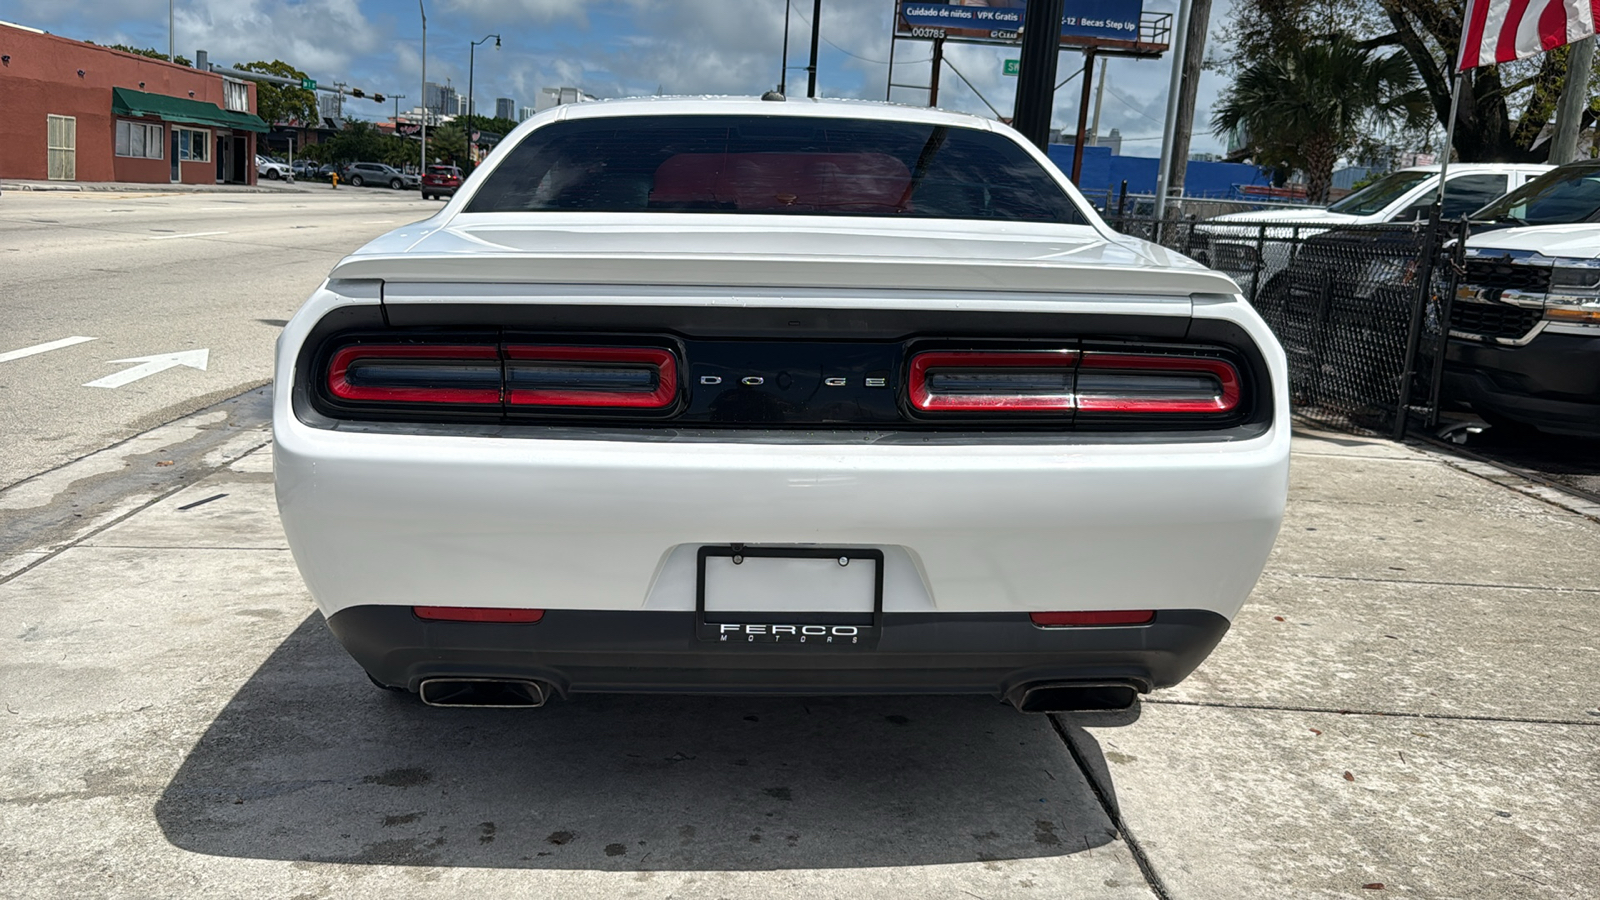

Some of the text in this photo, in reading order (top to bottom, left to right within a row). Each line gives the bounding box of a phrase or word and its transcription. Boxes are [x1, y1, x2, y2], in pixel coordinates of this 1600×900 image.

[906, 7, 938, 16] Cuidado
[939, 9, 949, 17] de
[950, 10, 972, 18] niños
[977, 11, 994, 19] VPK
[995, 12, 1018, 21] Gratis
[1081, 18, 1104, 27] Becas
[1105, 19, 1123, 30] Step
[1124, 21, 1136, 32] Up
[912, 28, 945, 38] 003785
[720, 624, 858, 636] FERCO
[720, 635, 858, 643] MOTORS
